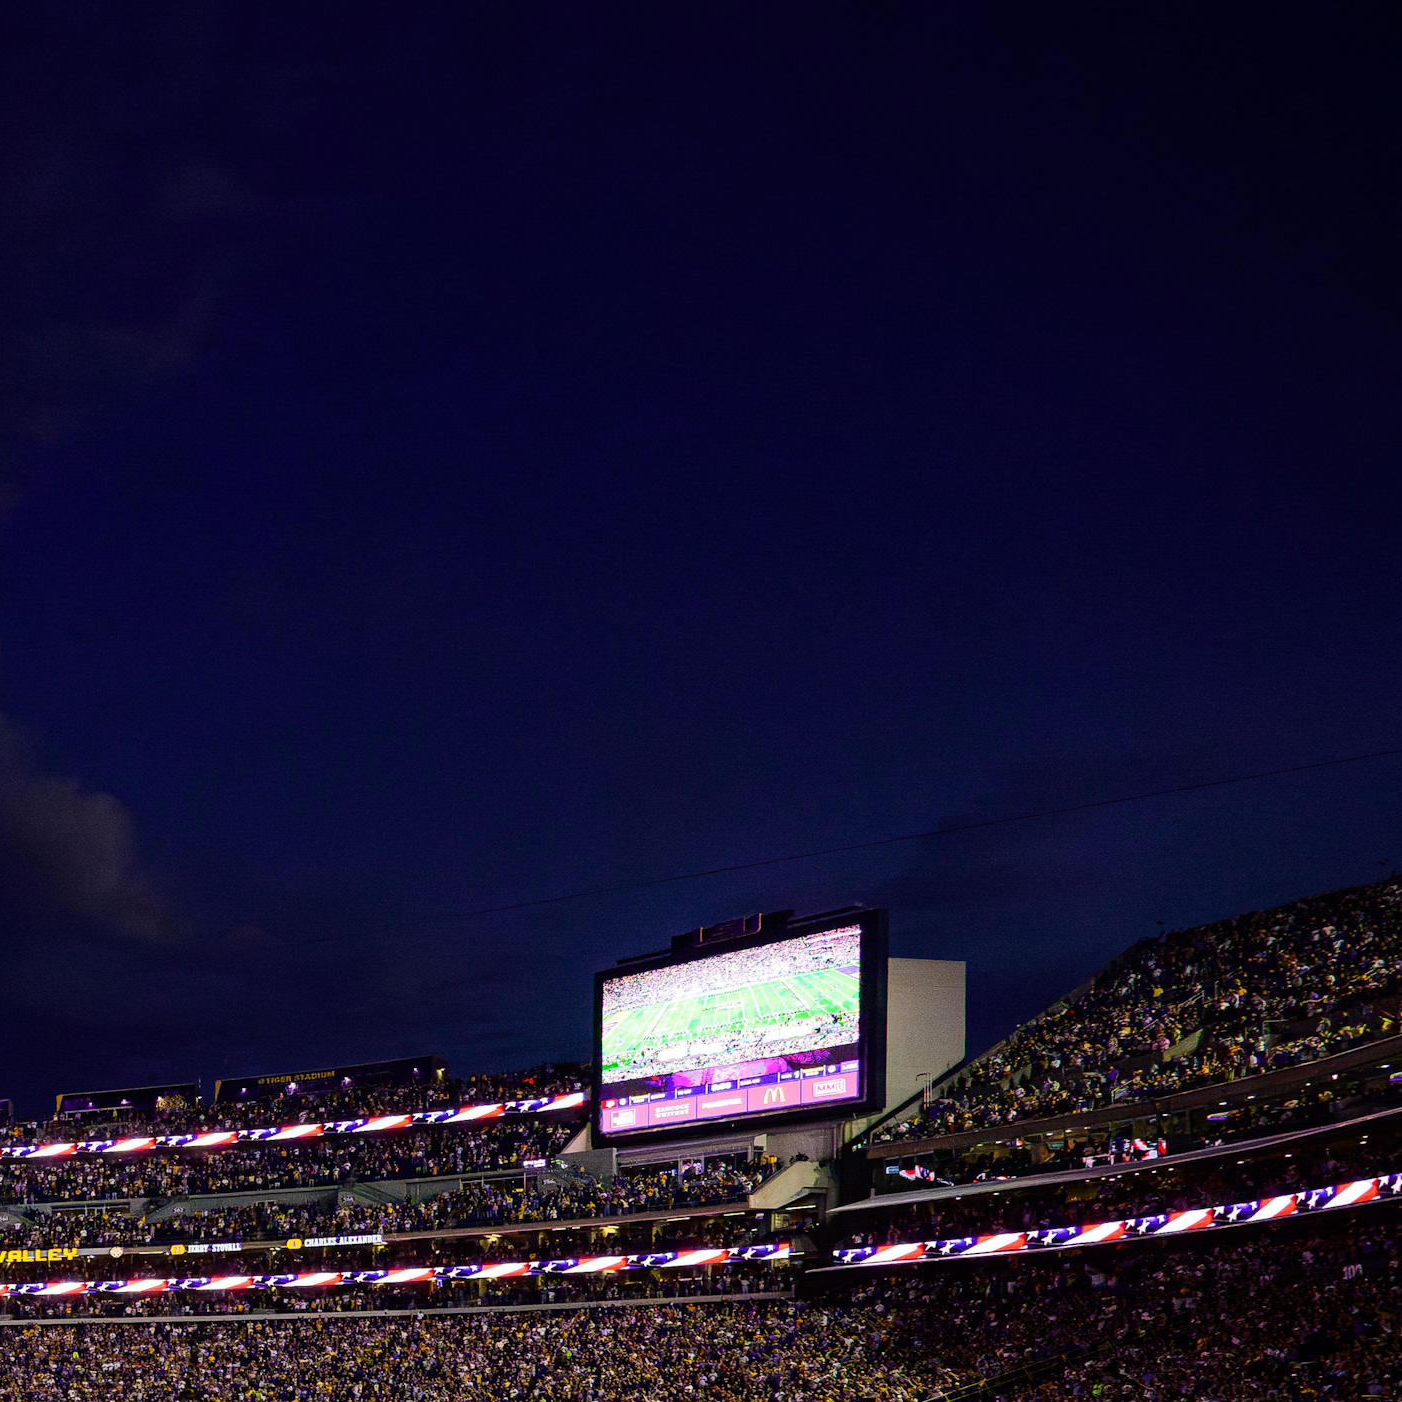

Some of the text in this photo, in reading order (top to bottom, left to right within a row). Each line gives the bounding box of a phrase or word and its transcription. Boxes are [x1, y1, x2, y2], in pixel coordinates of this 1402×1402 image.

[265, 1070, 336, 1085] TIGER STADIUM
[304, 1237, 337, 1247] CHARLES
[338, 1235, 382, 1246] ALEXANDER
[188, 1244, 209, 1253] JERRY
[211, 1243, 242, 1252] STOVALL
